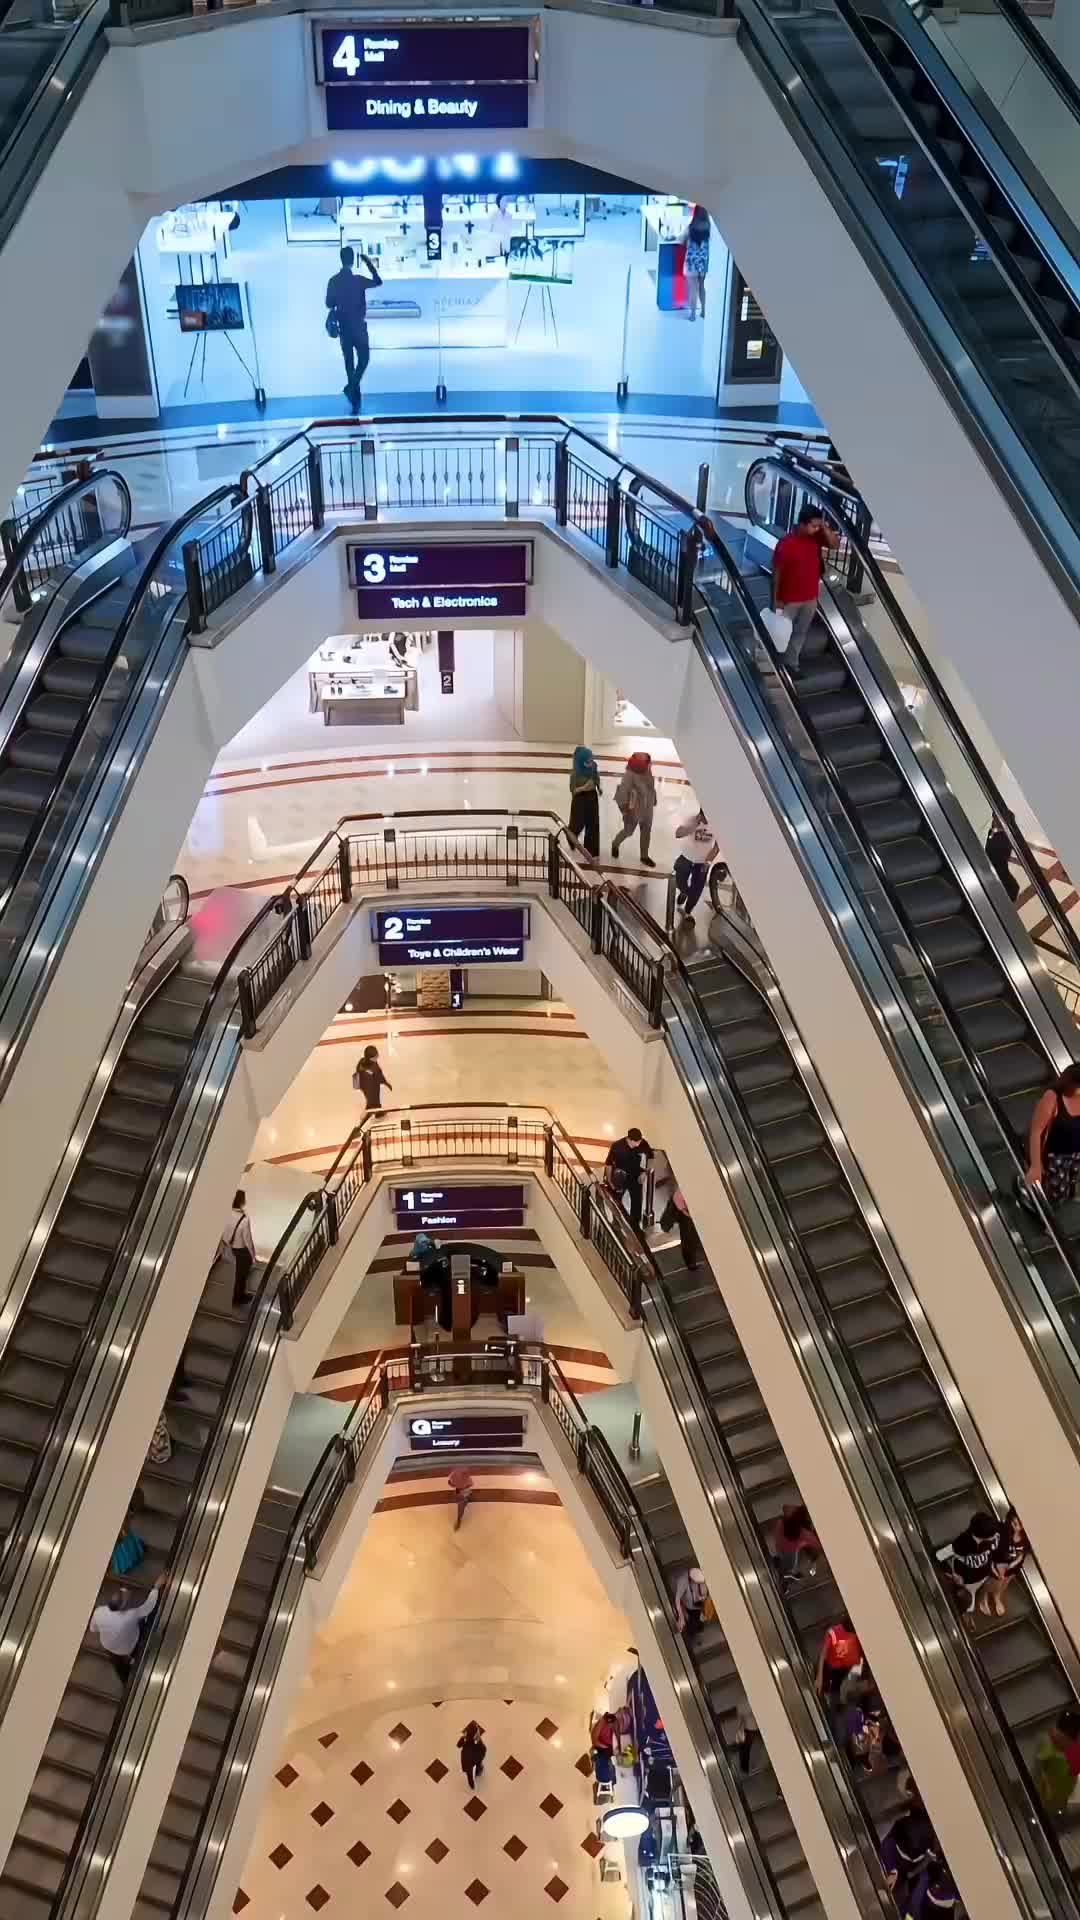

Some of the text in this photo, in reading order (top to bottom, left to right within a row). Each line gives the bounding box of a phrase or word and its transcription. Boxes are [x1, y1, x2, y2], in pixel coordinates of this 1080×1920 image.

[332, 34, 361, 77] 4
[366, 98, 478, 119] Dining & Beauty
[428, 232, 440, 249] 3
[363, 553, 386, 583] 3
[391, 595, 498, 609] Tech & Electronics
[443, 675, 452, 686] 2
[384, 917, 404, 940] 2
[408, 946, 520, 960] Toys & Children's Wear
[402, 1191, 415, 1210] 1
[421, 1216, 457, 1225] Fashion
